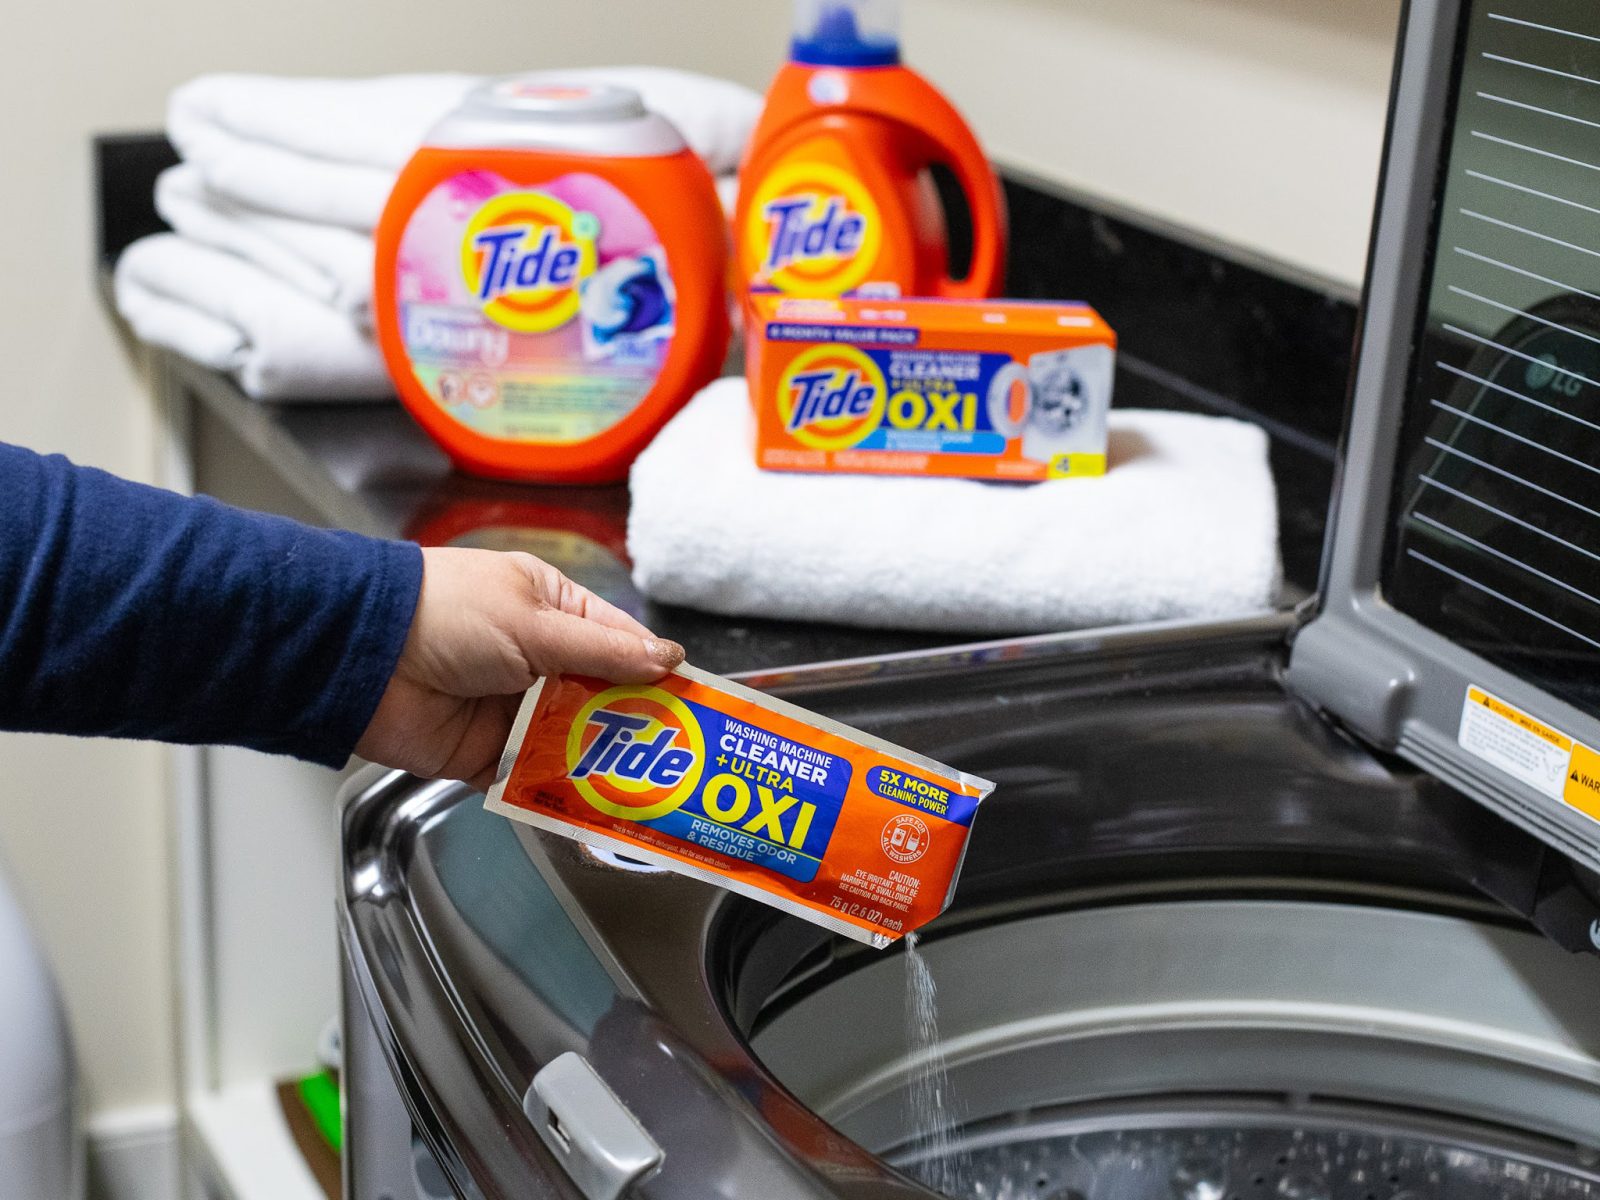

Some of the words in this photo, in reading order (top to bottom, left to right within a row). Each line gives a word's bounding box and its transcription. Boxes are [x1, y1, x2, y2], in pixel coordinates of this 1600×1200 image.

[763, 194, 866, 274] Tide
[473, 225, 579, 300] Tide
[786, 368, 877, 432] Tide
[888, 391, 978, 431] OXI
[568, 709, 697, 789] Tide
[720, 734, 828, 787] CLEANER
[725, 719, 777, 749] WASHING
[780, 741, 832, 769] MACHINE
[878, 783, 917, 805] CLEANING
[879, 769, 902, 787] 5X
[903, 778, 949, 804] MORE
[702, 773, 817, 850] OXI
[896, 816, 914, 826] SAFE
[914, 817, 926, 834] FOR
[686, 831, 696, 842] &
[691, 819, 756, 850] REMOVES
[757, 843, 797, 865] ODOR
[883, 837, 891, 853] ALL
[889, 850, 922, 862] WASHERS
[838, 882, 849, 892] SEE
[849, 885, 871, 899] CAUTION
[870, 893, 879, 902] ON
[879, 895, 894, 908] BACK
[840, 873, 868, 890] HARMFUL
[869, 883, 877, 891] IF
[875, 885, 913, 906] SWALLOWED.
[855, 869, 868, 880] EYE
[867, 874, 894, 889] IRRITANT.
[895, 883, 910, 895] MAY
[909, 888, 919, 898] BE
[888, 870, 921, 890] CAUTION:
[830, 895, 843, 909] 75
[841, 902, 849, 913] g
[847, 902, 868, 919] (2.6
[882, 917, 903, 932] each
